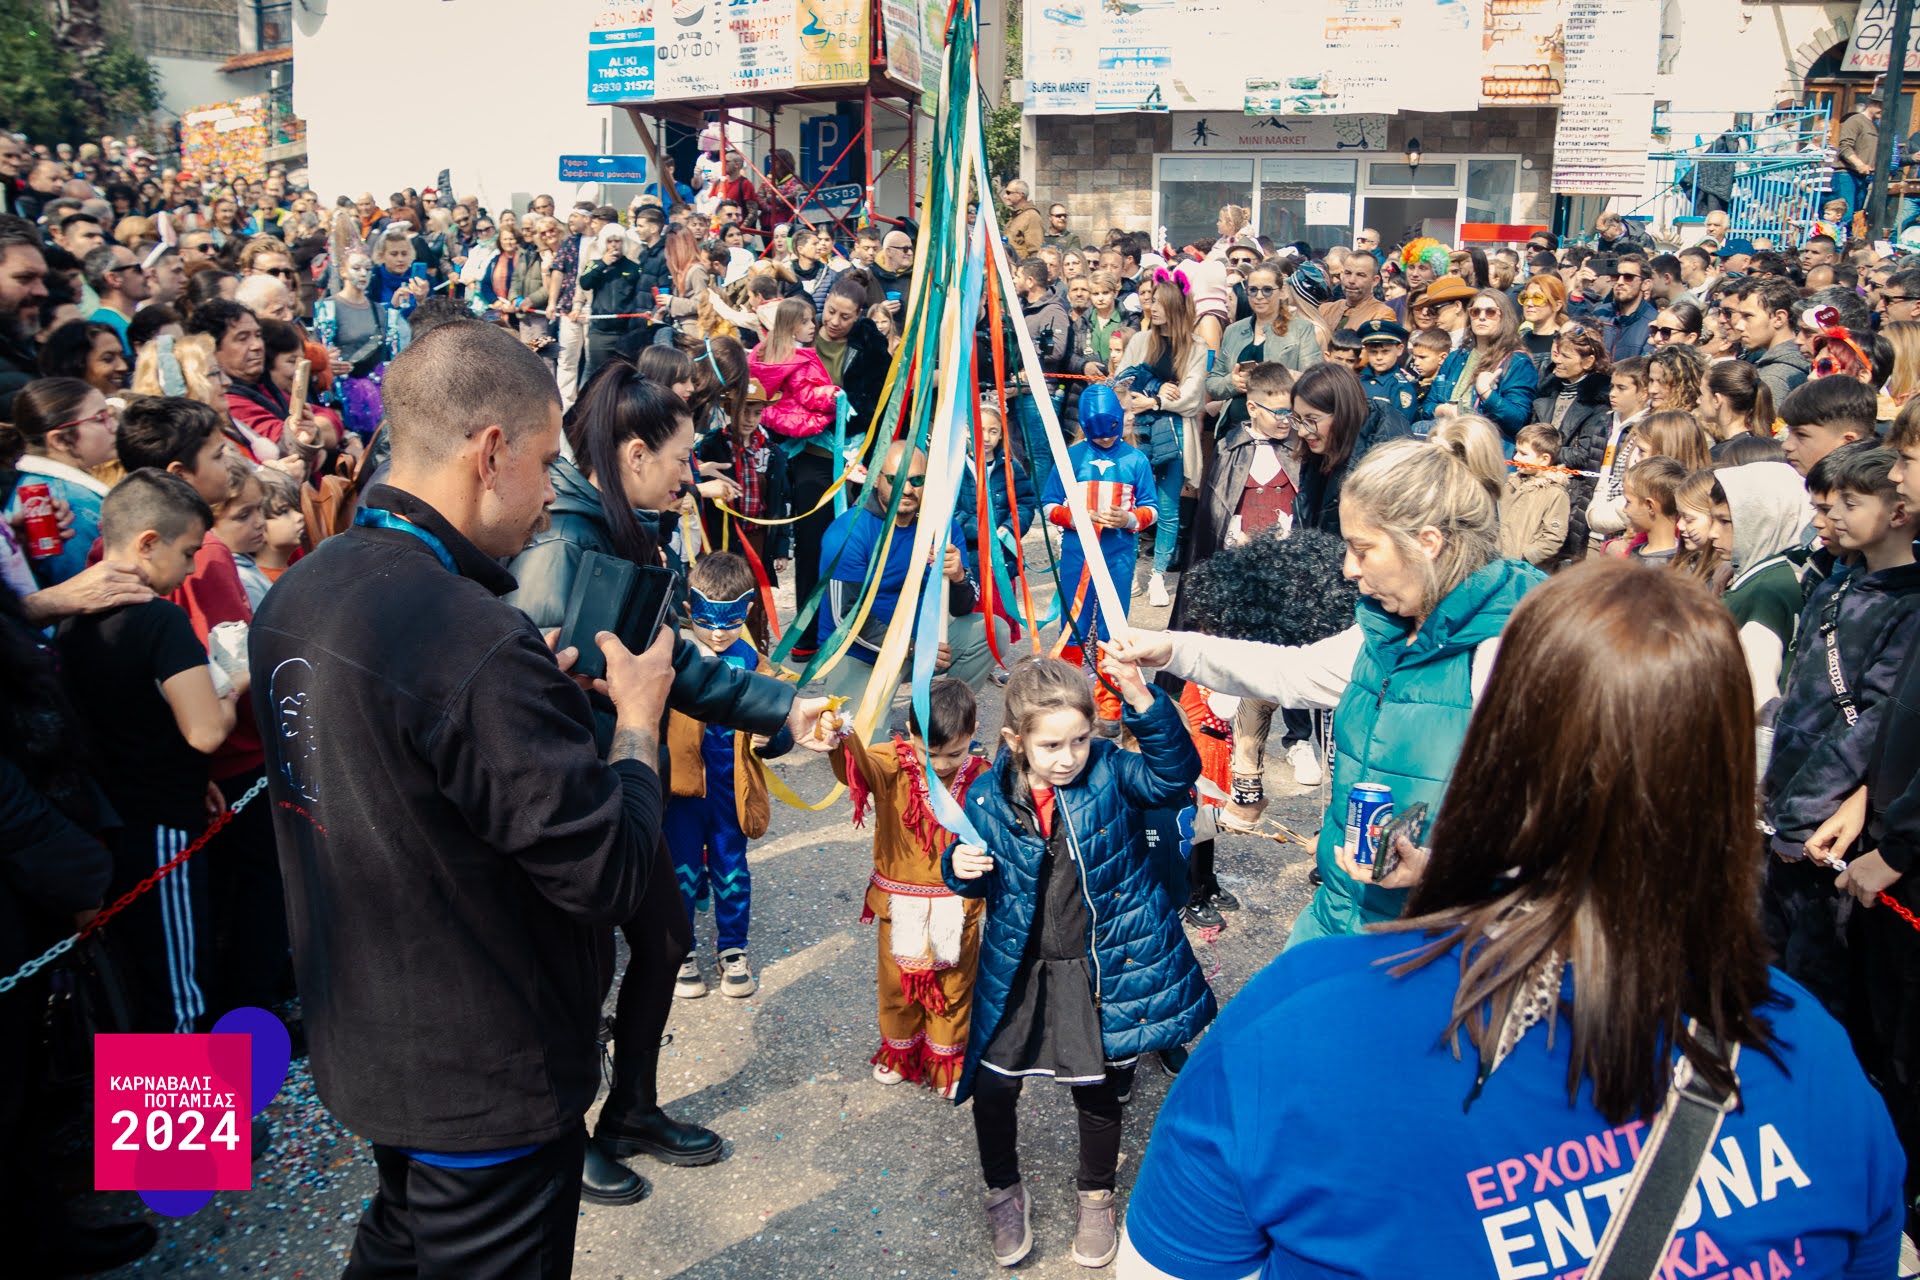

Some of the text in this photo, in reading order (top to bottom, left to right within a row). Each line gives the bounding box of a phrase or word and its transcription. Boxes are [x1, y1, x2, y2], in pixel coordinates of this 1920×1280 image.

[821, 9, 860, 27] Cafe
[839, 32, 863, 49] Bar
[657, 41, 720, 60] ΦΟΥΦΟΥ
[608, 56, 638, 67] ALIKI
[598, 66, 649, 78] THASSOS
[801, 61, 863, 81] Potamia
[592, 82, 622, 93] 25930
[1031, 82, 1091, 93] SUPER MARKET
[1484, 80, 1559, 95] ΠΟΤΑΜΙΑ
[818, 121, 839, 162] P
[1239, 136, 1307, 145] MINI MARKET
[1819, 311, 1836, 321] LOVE
[1466, 1113, 1660, 1211] ΕΡΧΟΝΤ
